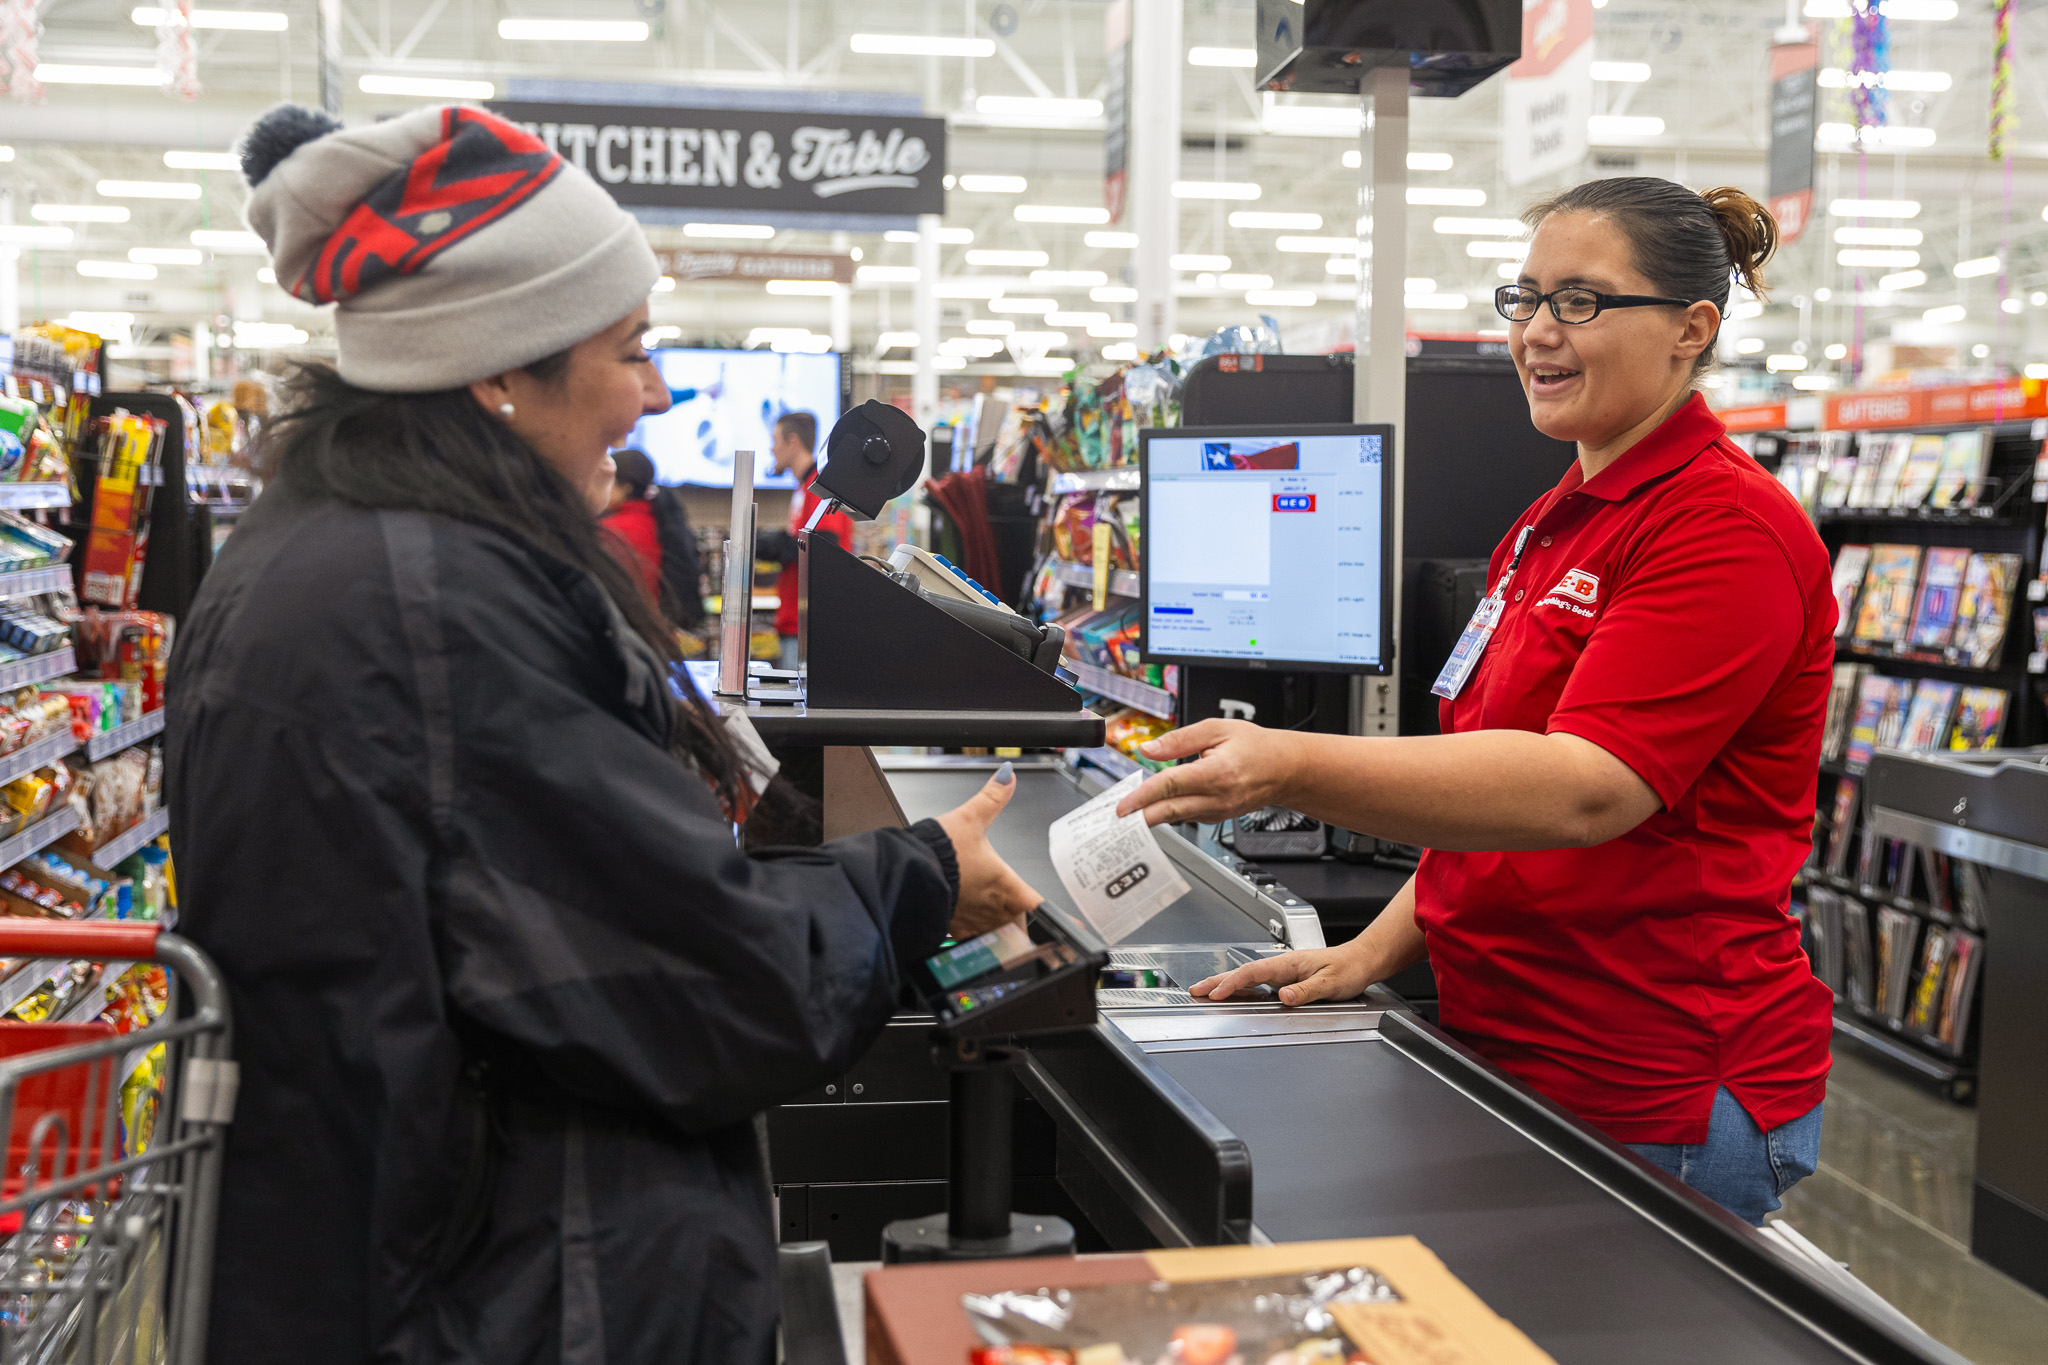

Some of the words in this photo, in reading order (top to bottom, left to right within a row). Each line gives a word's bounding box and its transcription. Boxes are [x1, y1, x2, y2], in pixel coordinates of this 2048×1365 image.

[518, 121, 740, 188] ITCHEN
[743, 129, 782, 190] &
[788, 125, 931, 183] Table
[1558, 575, 1595, 597] E-B
